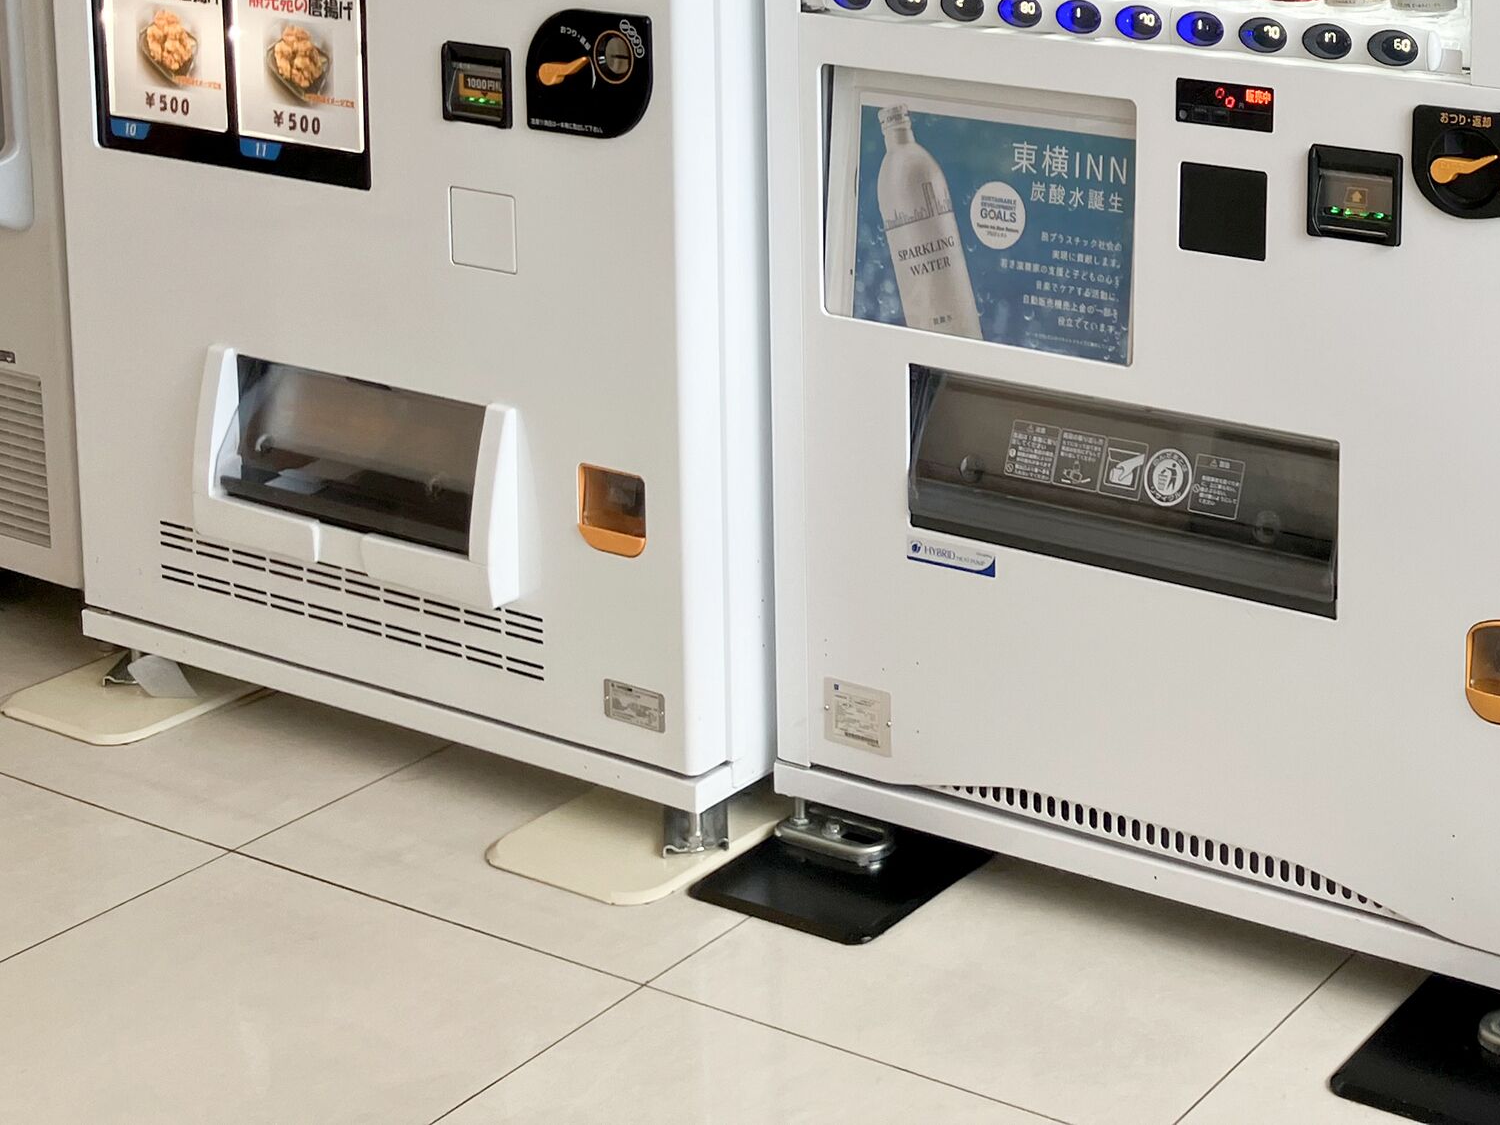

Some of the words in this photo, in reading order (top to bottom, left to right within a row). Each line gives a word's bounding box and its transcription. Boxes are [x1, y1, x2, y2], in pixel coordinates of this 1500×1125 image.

[1245, 89, 1272, 105] 販売中
[125, 123, 136, 136] 10
[256, 144, 266, 156] 11
[1011, 141, 1127, 185] 東横INN
[1030, 181, 1125, 213] 炭酸水誕生
[980, 208, 1017, 224] GOALS
[898, 236, 955, 261] SPARKLING
[909, 256, 951, 276] WATER
[923, 546, 956, 561] HYBRID
